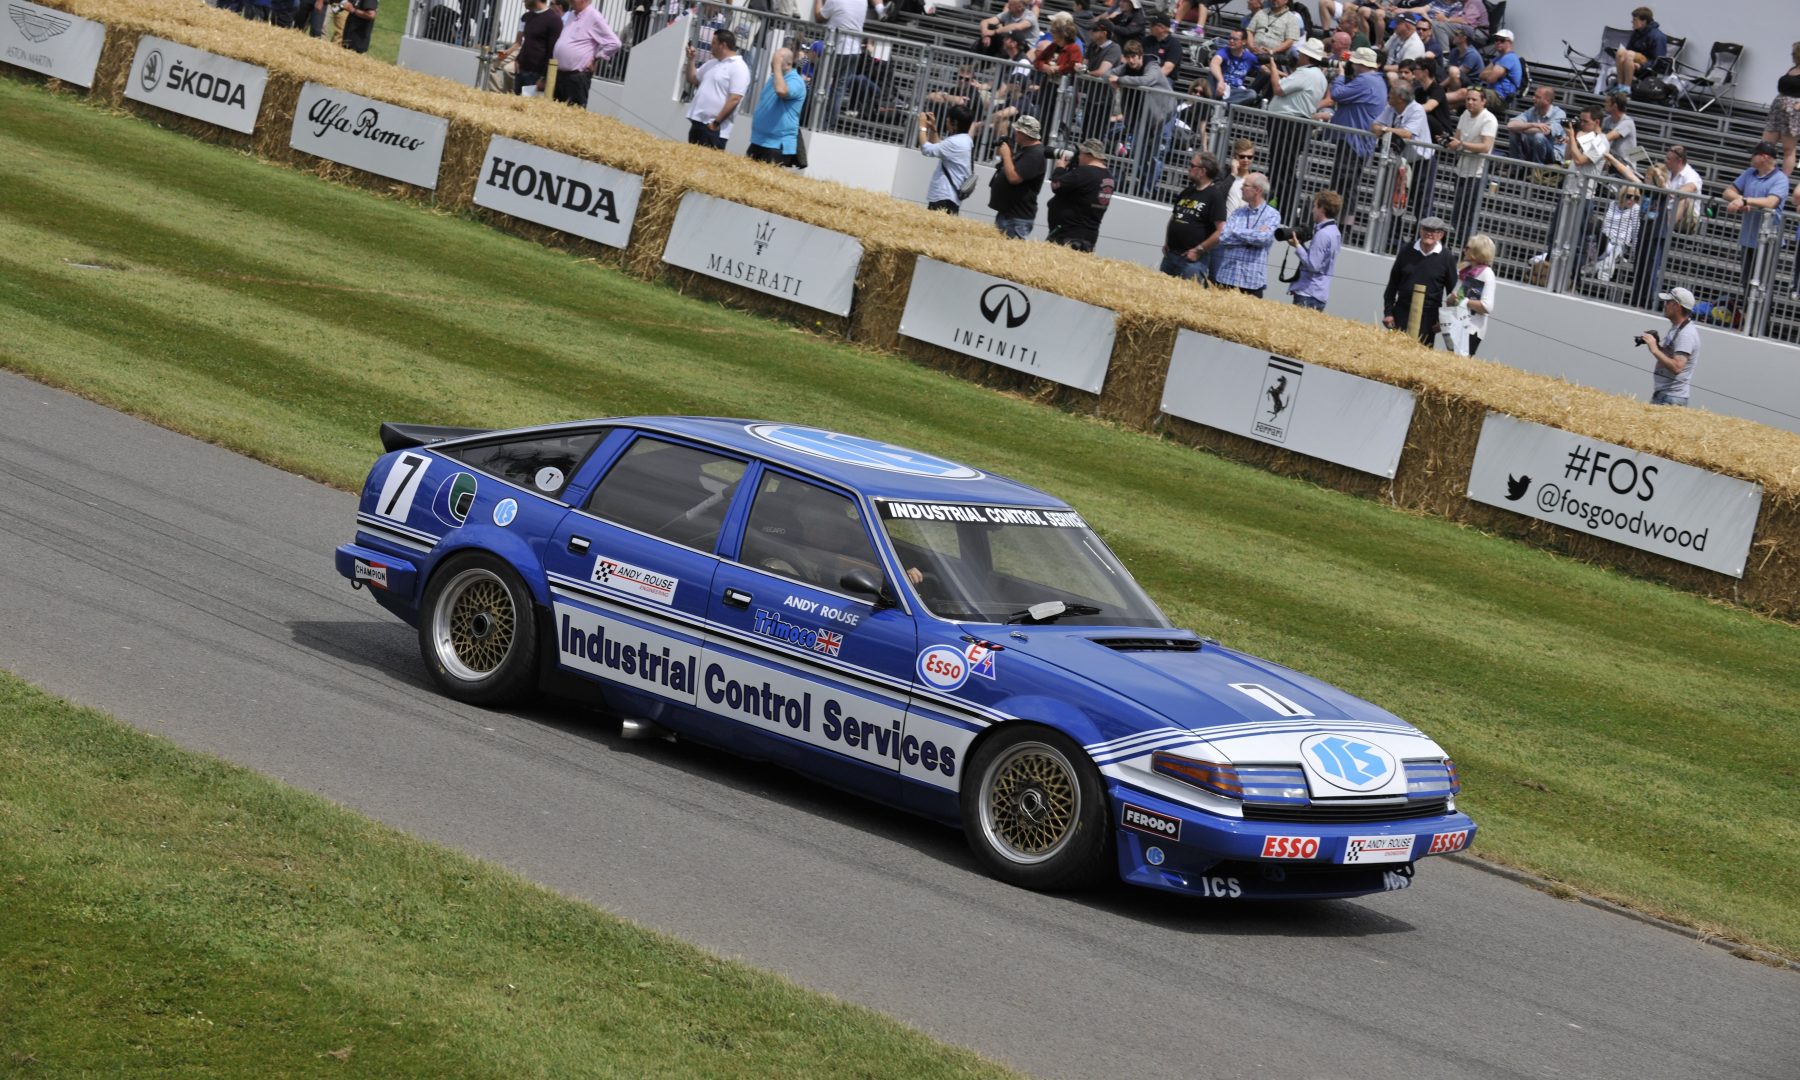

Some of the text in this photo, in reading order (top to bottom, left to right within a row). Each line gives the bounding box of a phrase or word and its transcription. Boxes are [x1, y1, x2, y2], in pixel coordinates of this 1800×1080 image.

[166, 60, 246, 110] ŠKODA
[308, 98, 425, 151] Alfa Romeo
[486, 156, 620, 224] HONDA
[706, 253, 803, 297] MASERATI
[953, 327, 1038, 366] INFINITI
[1255, 422, 1283, 438] Ferrari
[545, 473, 555, 484] 7
[1564, 444, 1659, 502] #FOS
[384, 455, 423, 516] 7
[888, 502, 986, 523] INDUSTRIAL
[985, 508, 1049, 526] CONTROL
[1536, 483, 1709, 552] @fosgoodwood
[355, 564, 386, 582] CHAMPION
[617, 567, 675, 590] ANDY ROUSE
[639, 585, 669, 598] ENGINEERING
[783, 595, 860, 626] ANDY ROUSE
[754, 609, 817, 649] Trimoco
[967, 645, 981, 663] E
[561, 613, 956, 777] Industrial Control Services
[1126, 810, 1176, 834] FERODO
[1262, 837, 1319, 859] ESSO
[1366, 837, 1412, 849] ANDY ROUSE
[1429, 832, 1466, 853] ESSO
[1201, 876, 1242, 898] ICS
